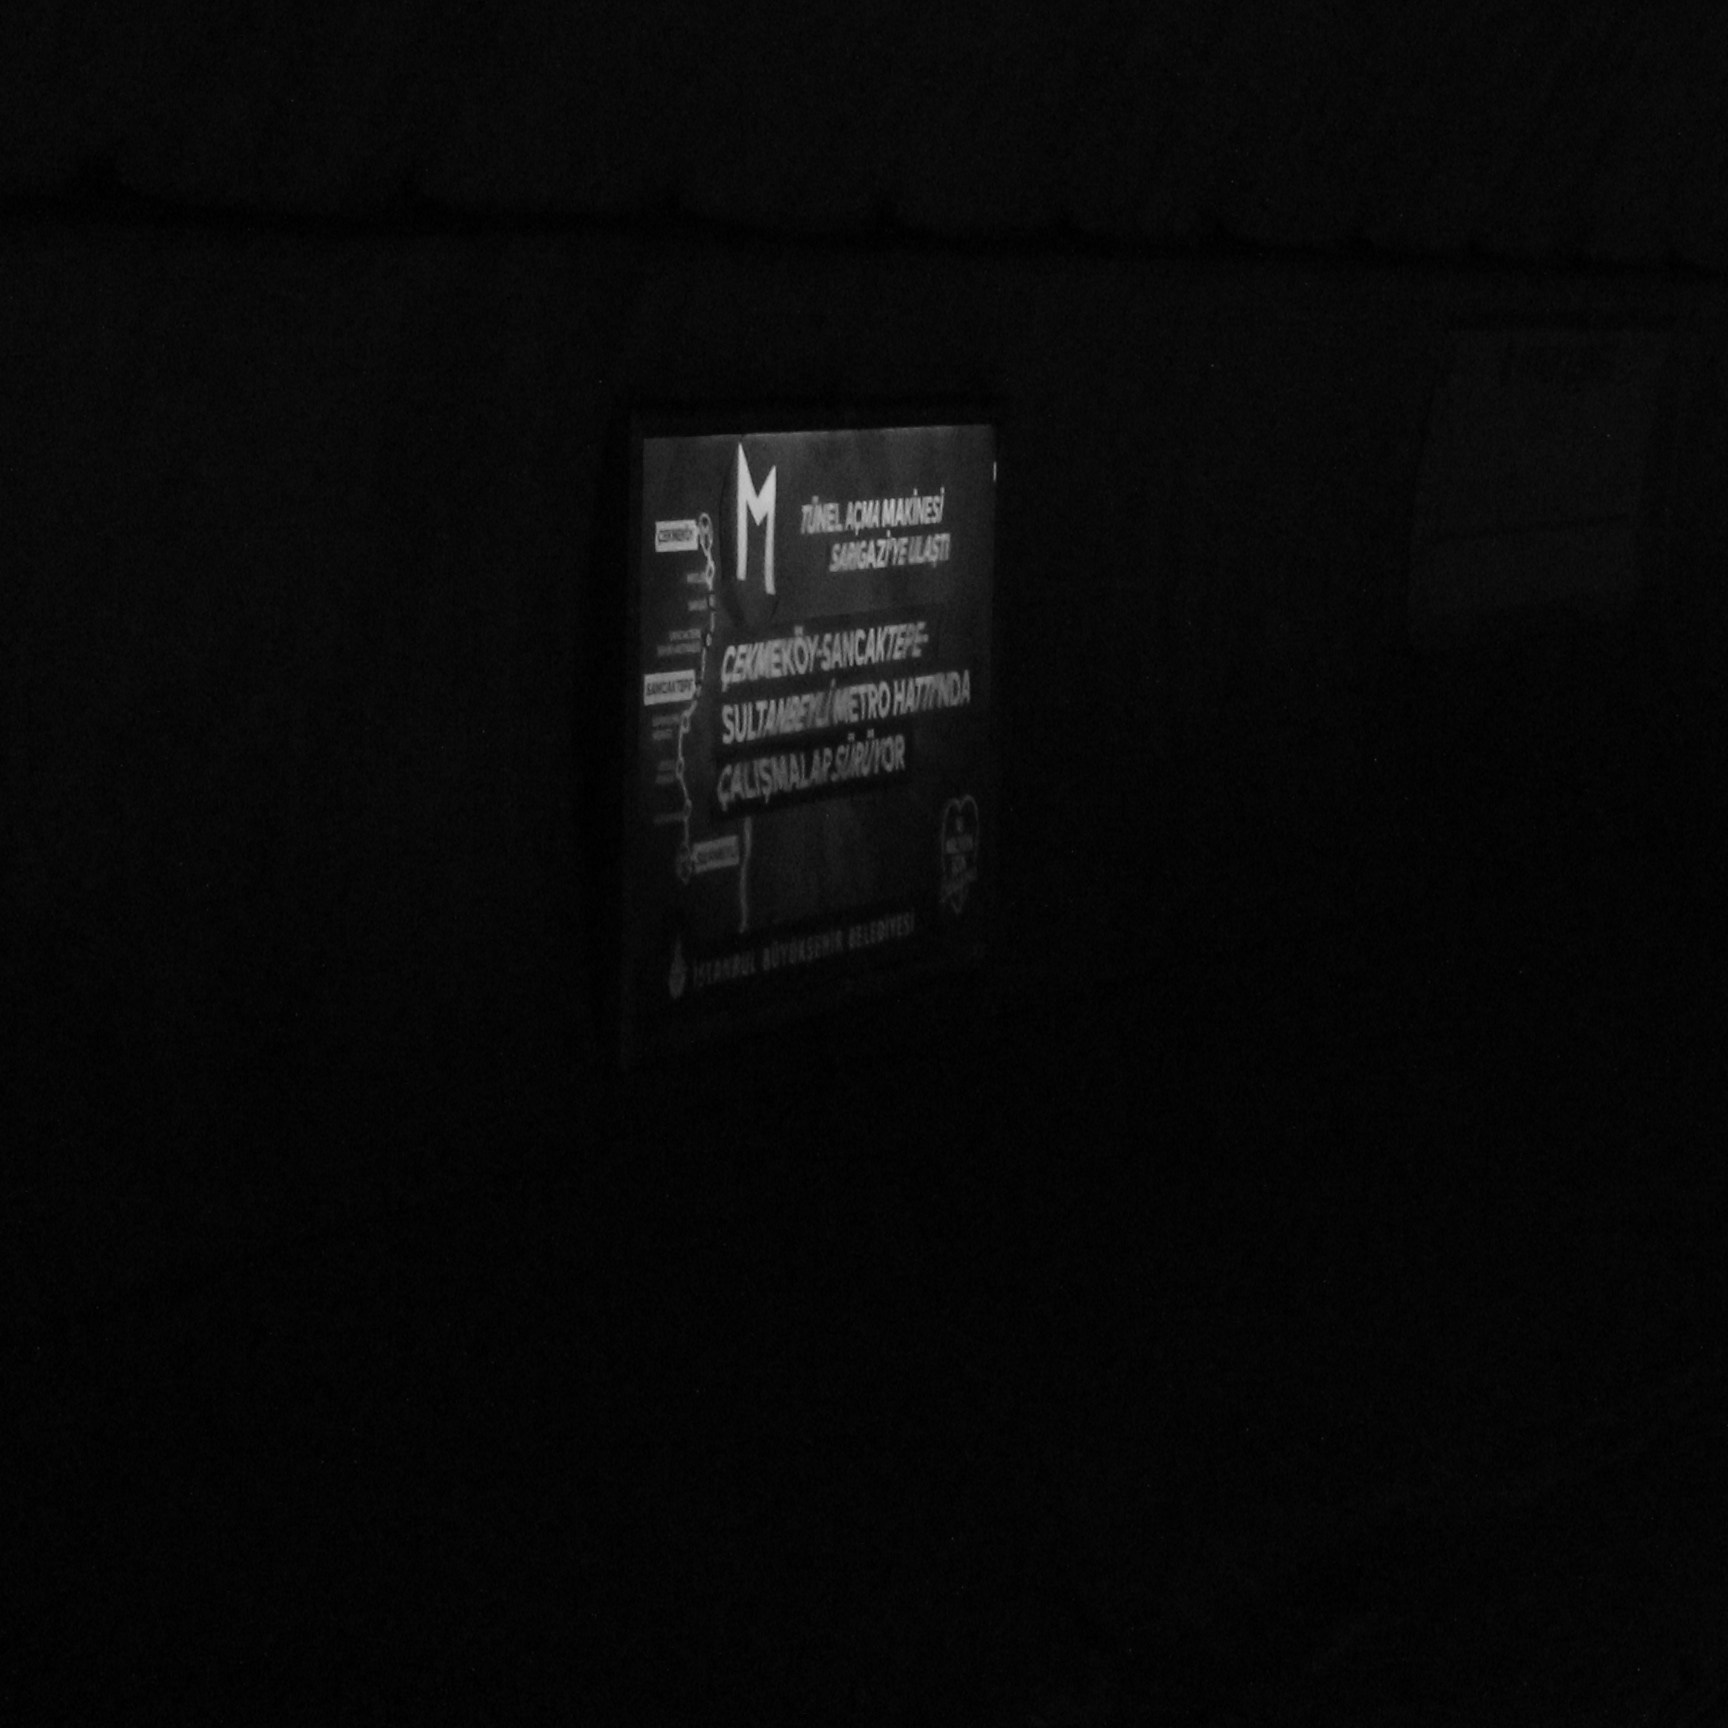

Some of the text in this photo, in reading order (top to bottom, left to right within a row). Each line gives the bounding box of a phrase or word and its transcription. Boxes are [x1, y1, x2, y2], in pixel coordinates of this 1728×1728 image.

[736, 441, 777, 596] M
[800, 486, 945, 535] TÜNEL AÇMA MAKİNESİ
[833, 680, 891, 724] METRO
[831, 728, 906, 782] SÜRÜYOR
